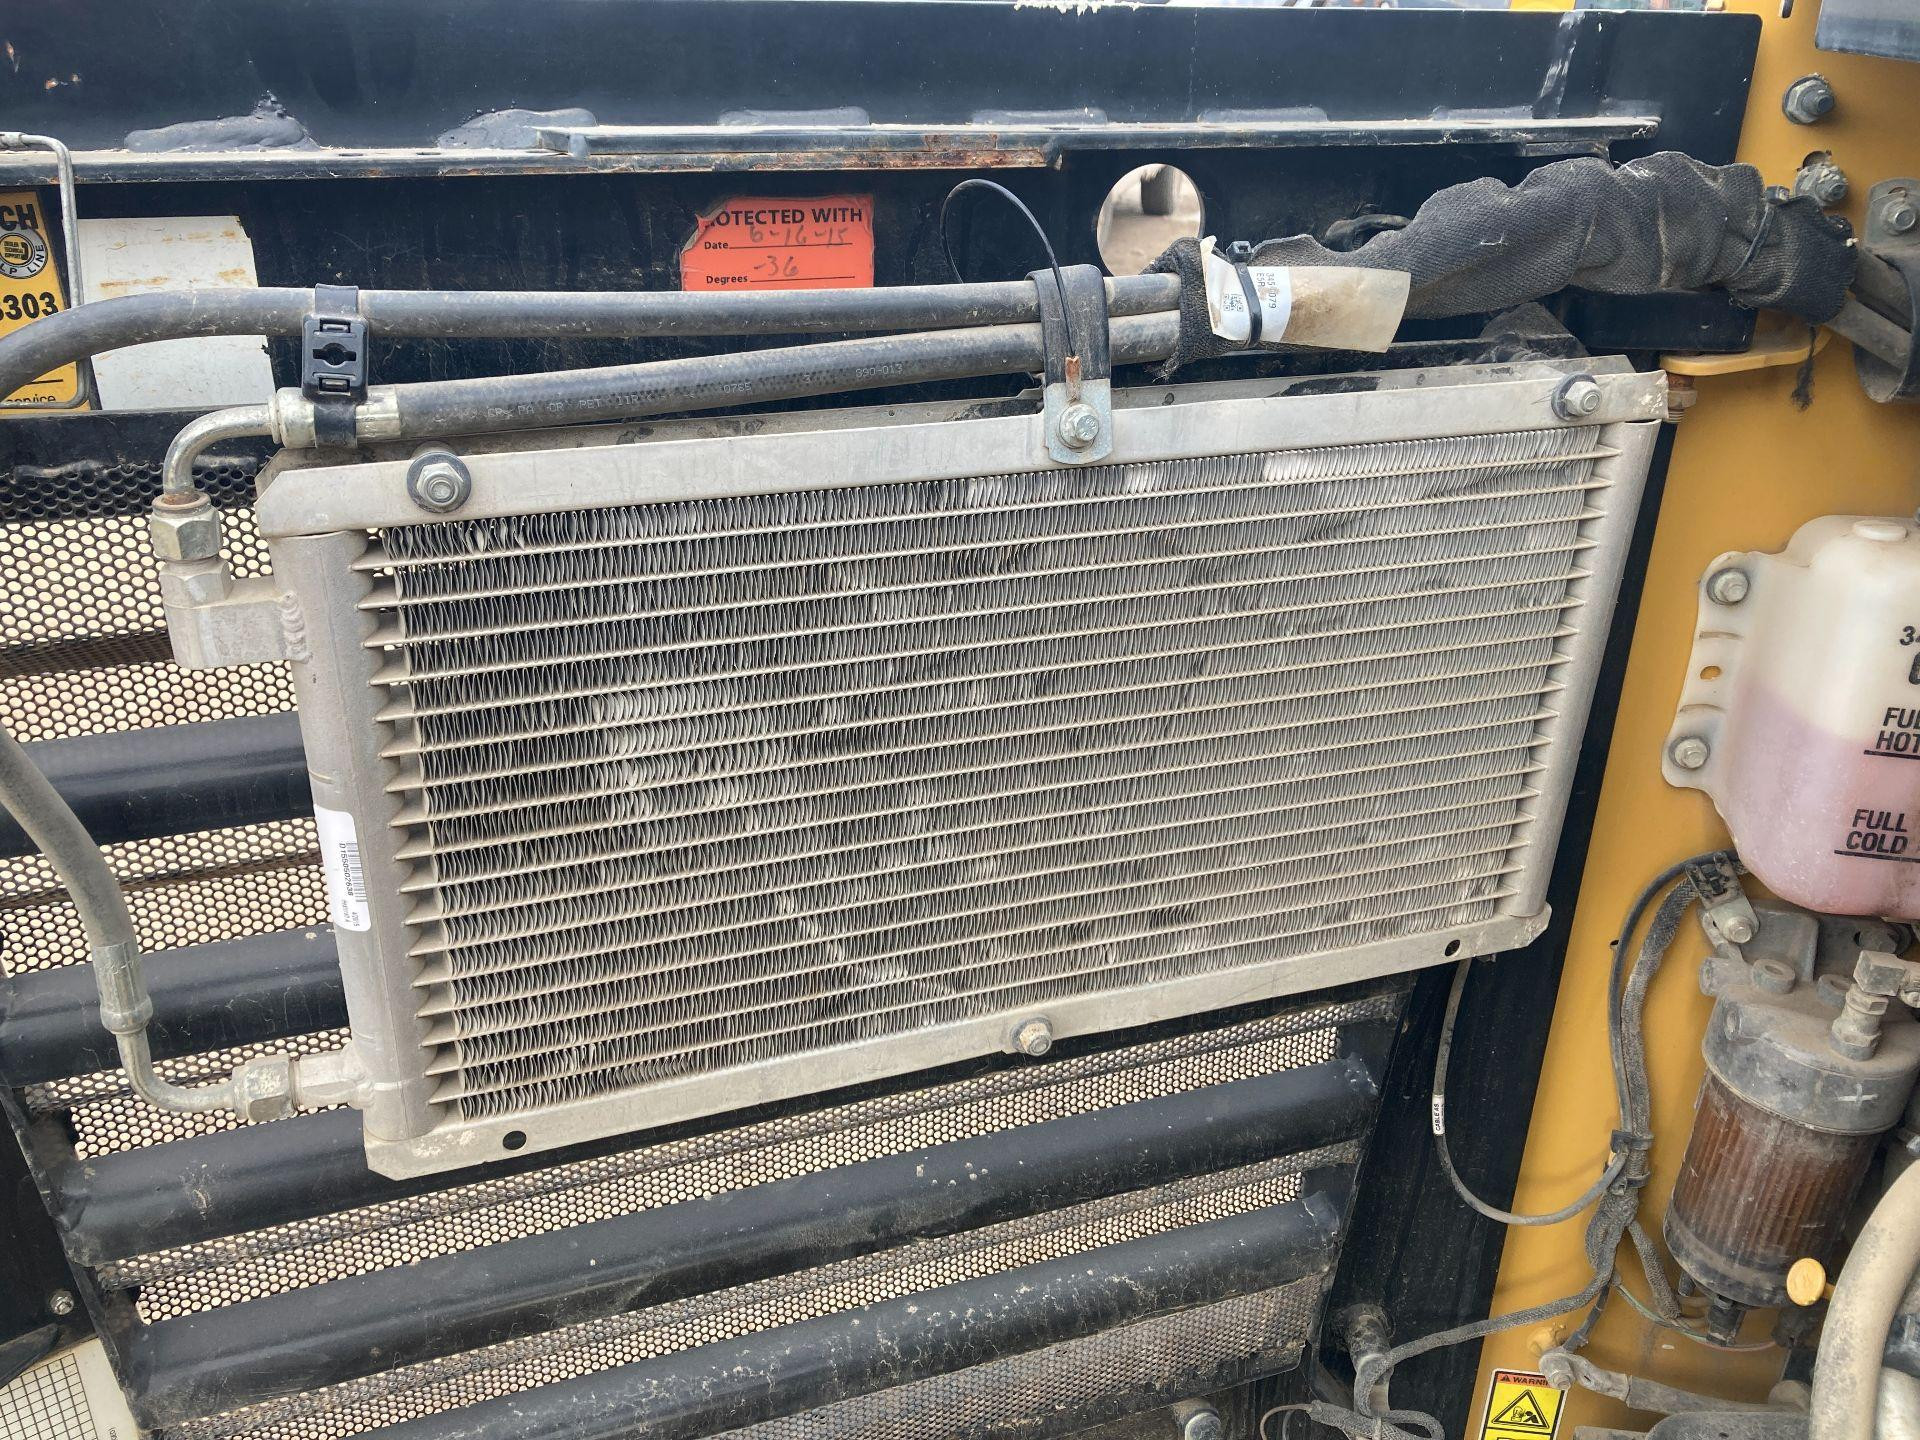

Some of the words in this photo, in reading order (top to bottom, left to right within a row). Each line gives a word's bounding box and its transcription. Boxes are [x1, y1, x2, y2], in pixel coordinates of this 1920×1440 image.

[705, 209, 804, 228] OTECTED
[811, 207, 862, 222] WITH
[704, 241, 729, 250] Date
[27, 245, 44, 273] LINE
[706, 275, 748, 285] Degrees
[0, 292, 58, 320] 303
[1852, 808, 1907, 832] FULL
[1846, 831, 1908, 854] COLD
